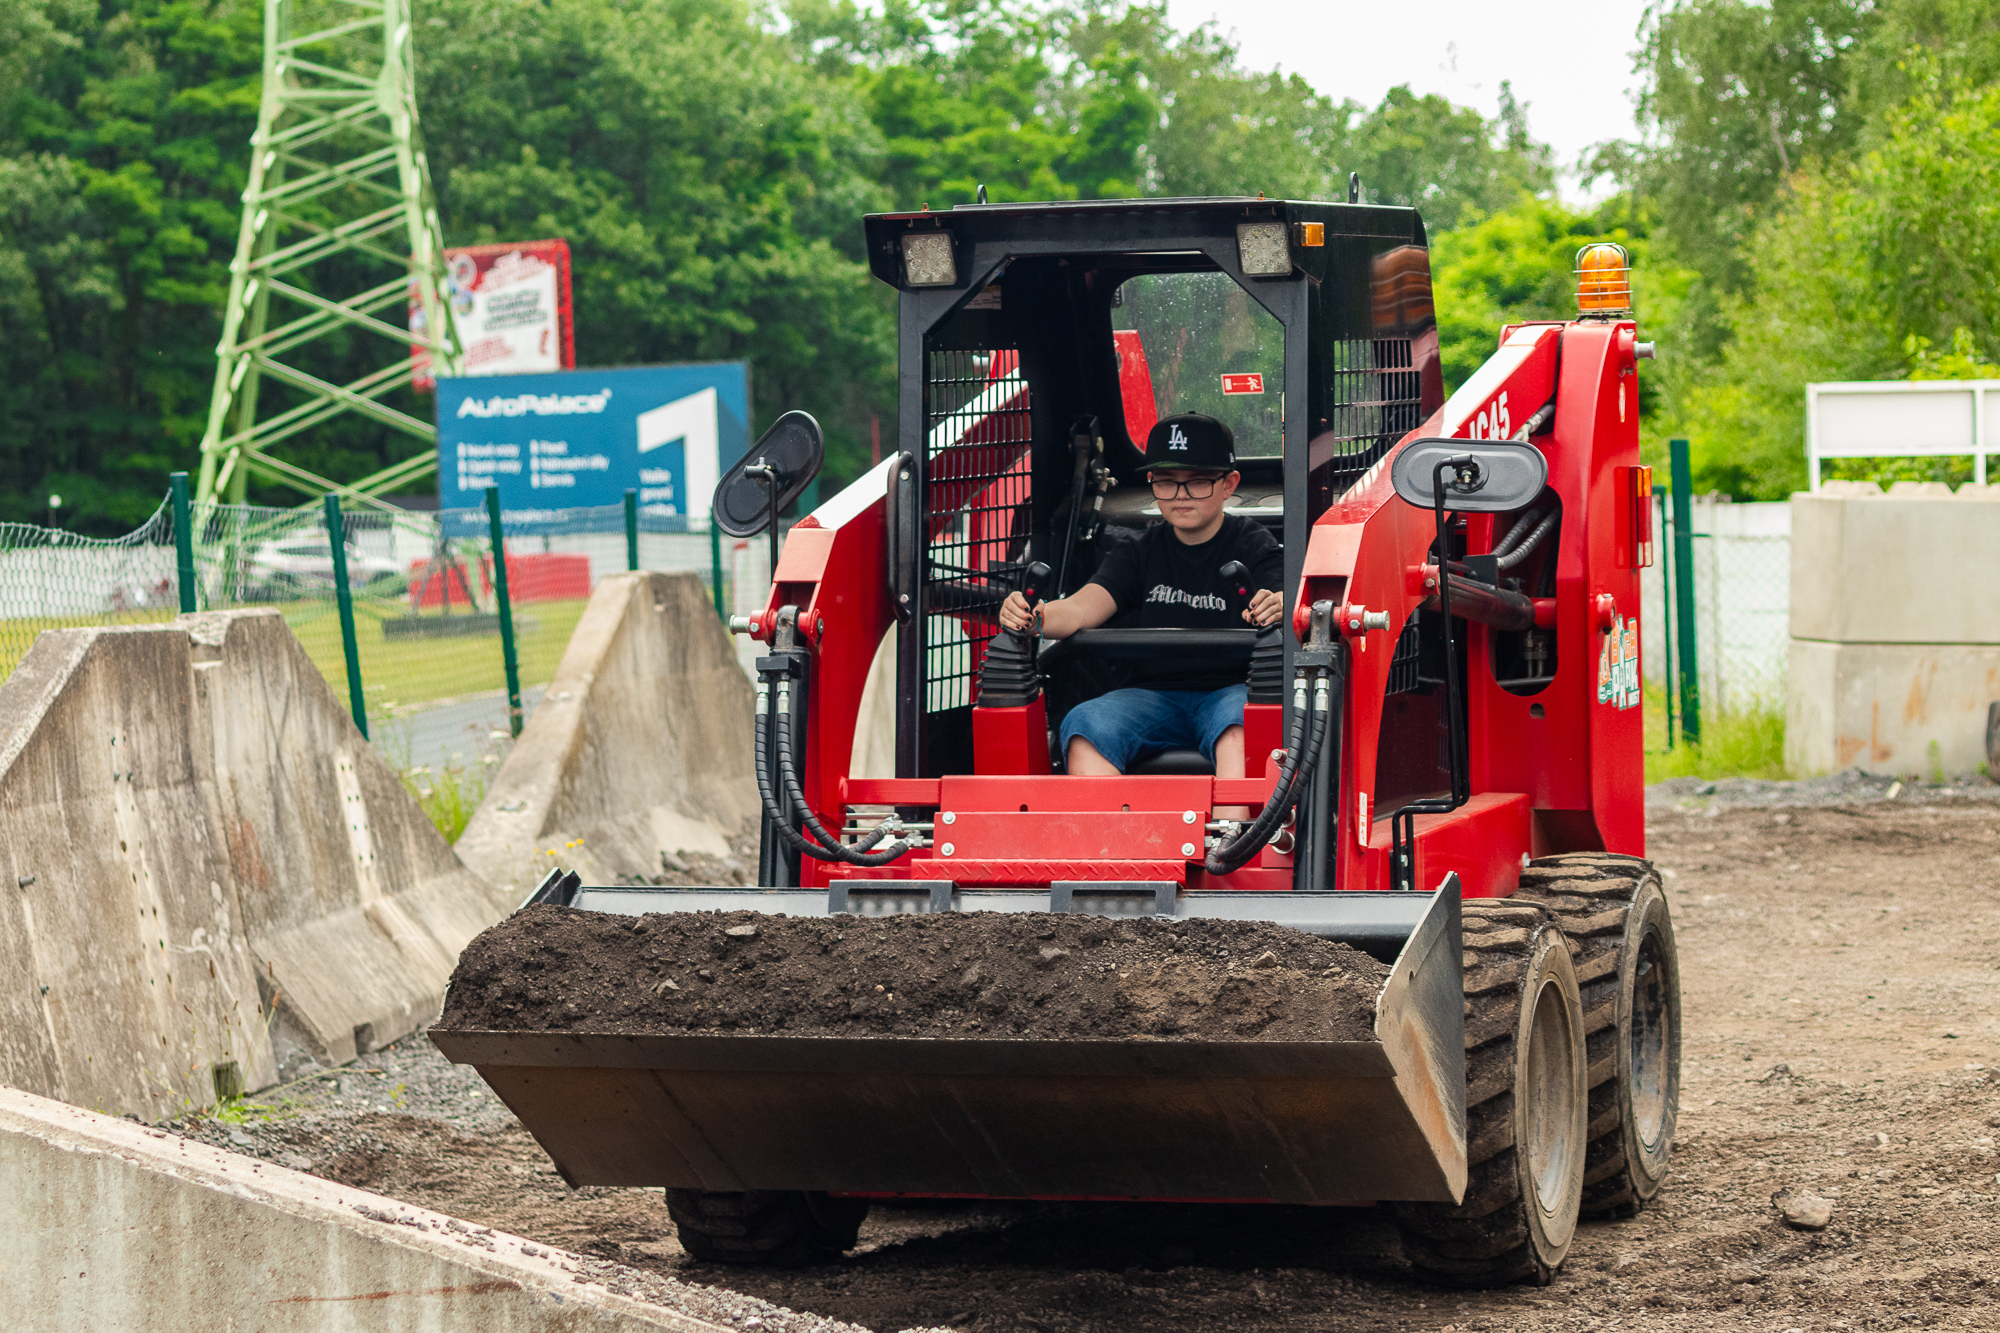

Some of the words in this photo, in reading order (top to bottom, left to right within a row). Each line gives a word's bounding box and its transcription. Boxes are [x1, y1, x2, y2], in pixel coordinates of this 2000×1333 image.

[457, 394, 608, 419] AutoPalace
[1168, 424, 1188, 450] LA
[1145, 584, 1226, 610] Memento
